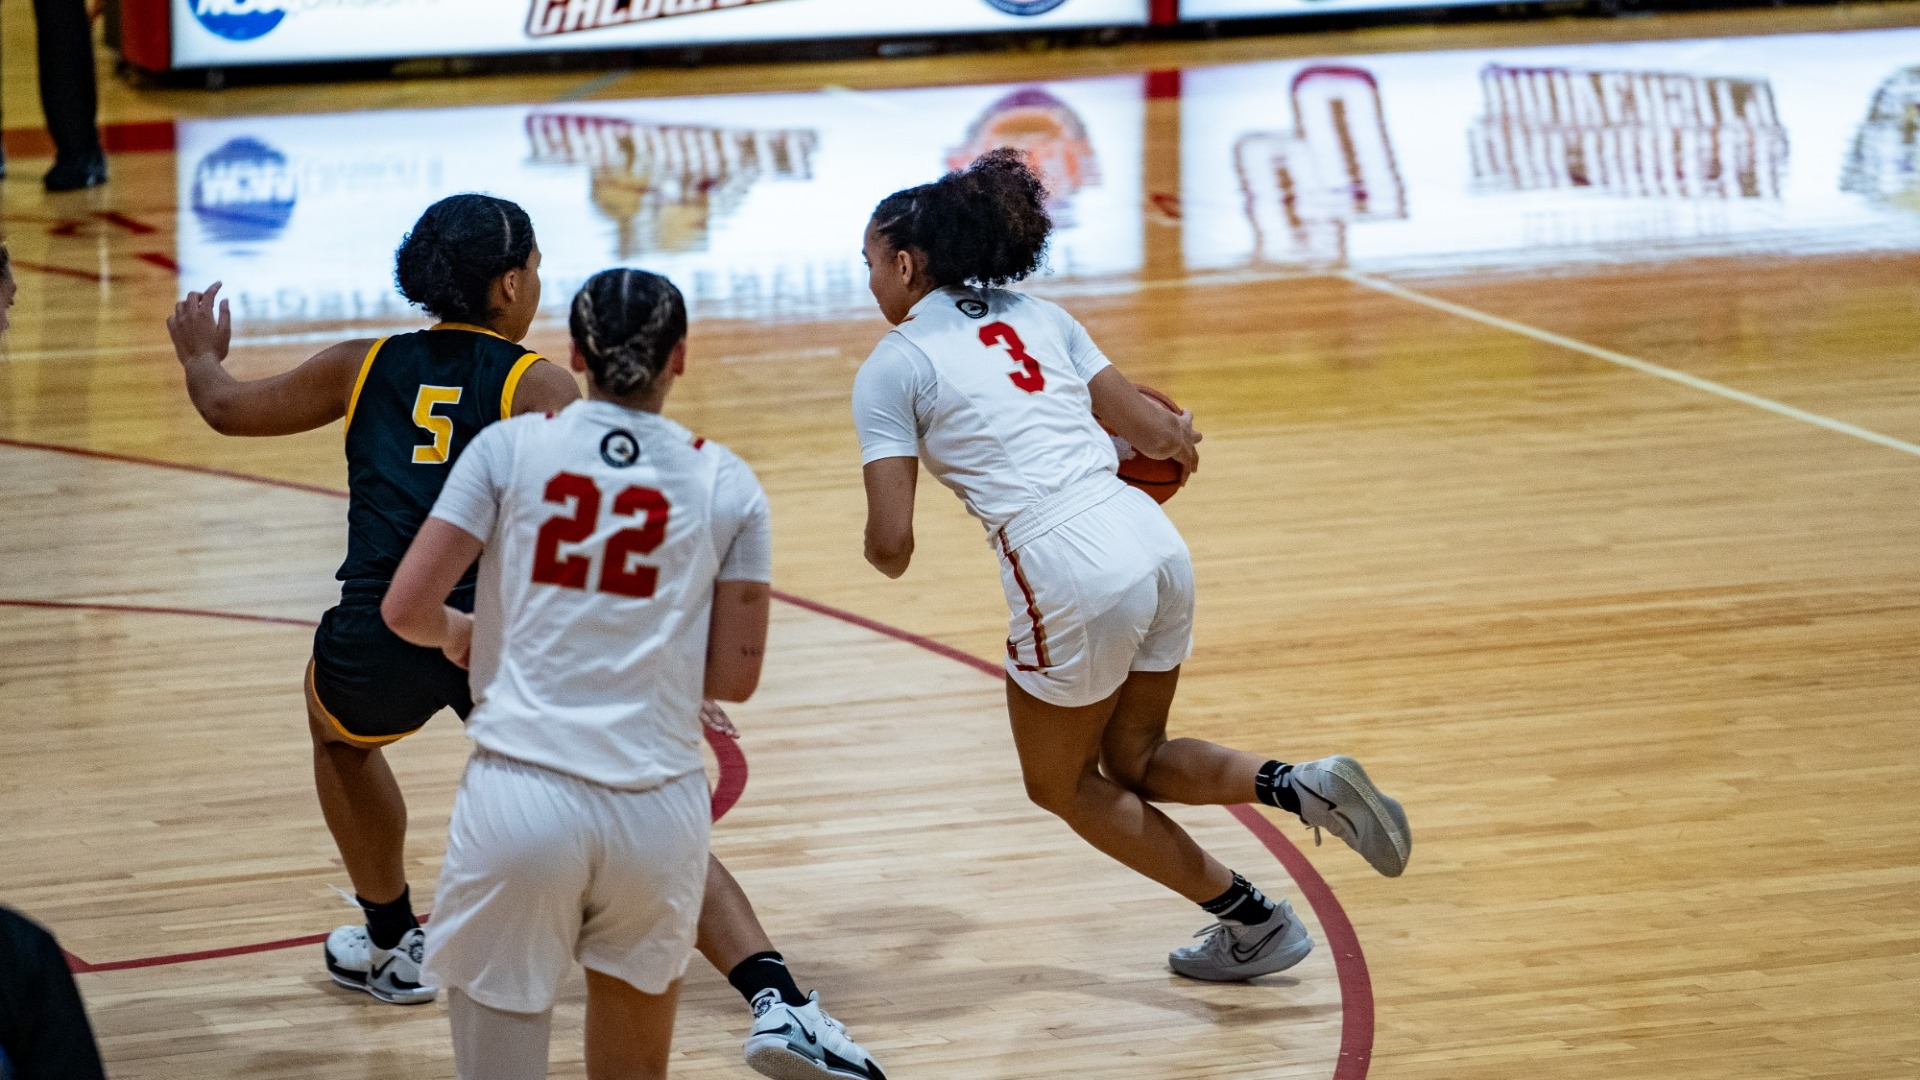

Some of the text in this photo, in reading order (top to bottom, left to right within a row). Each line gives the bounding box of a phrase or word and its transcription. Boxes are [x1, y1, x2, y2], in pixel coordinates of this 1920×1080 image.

[977, 321, 1046, 395] 3
[412, 384, 462, 464] 5
[532, 470, 671, 599] 22
